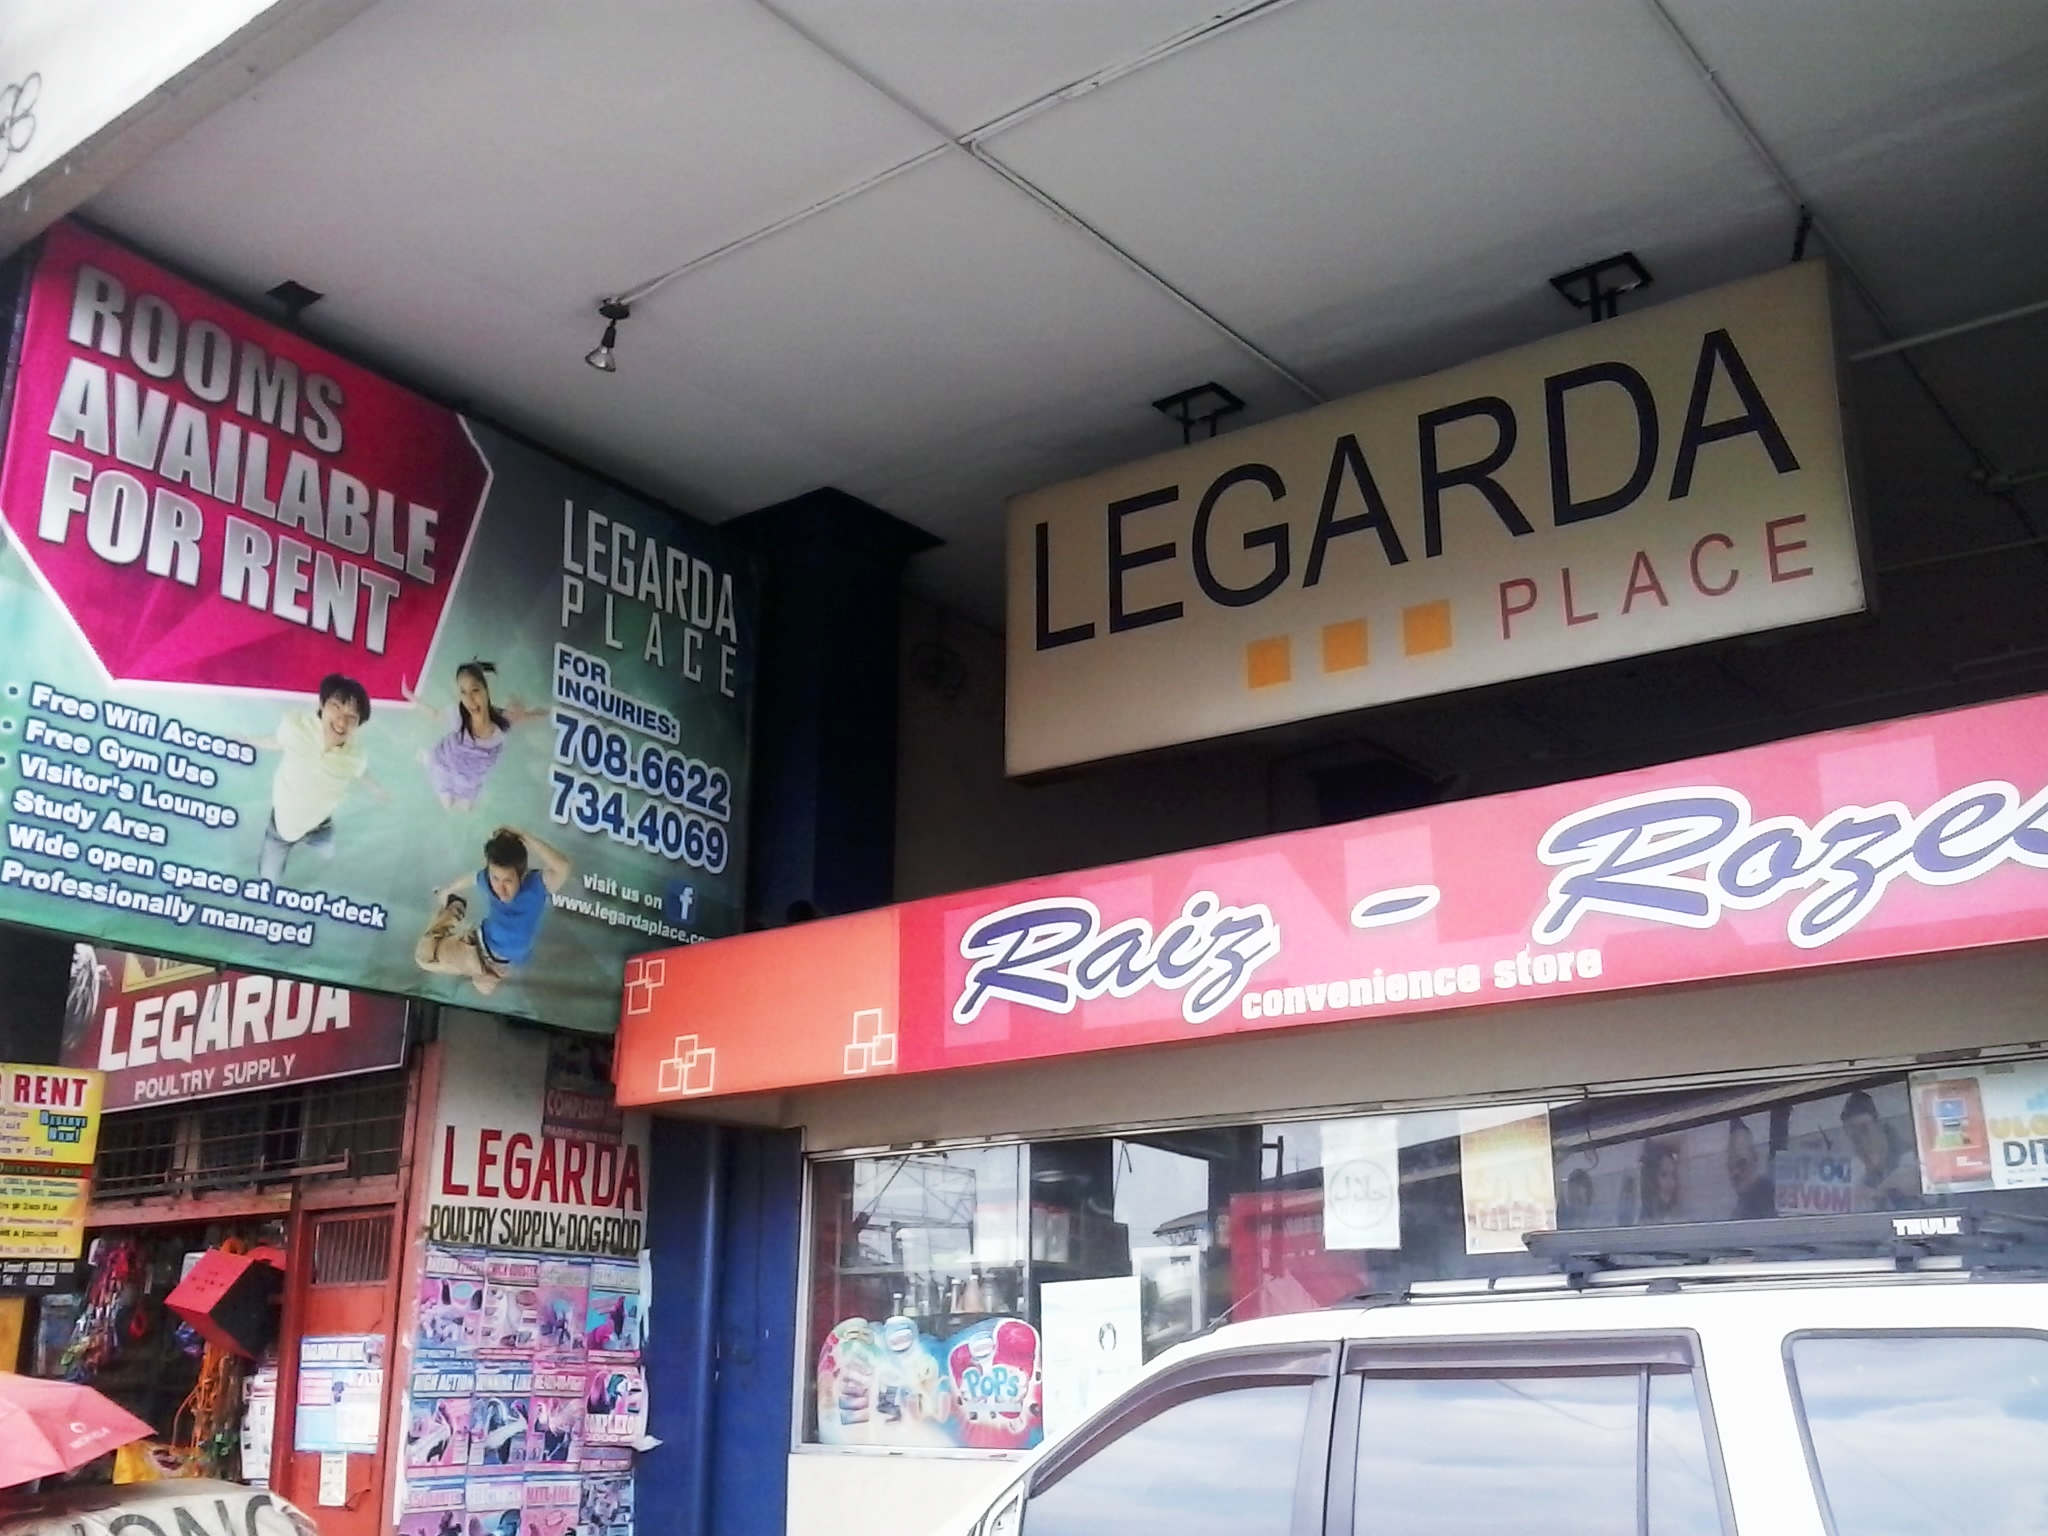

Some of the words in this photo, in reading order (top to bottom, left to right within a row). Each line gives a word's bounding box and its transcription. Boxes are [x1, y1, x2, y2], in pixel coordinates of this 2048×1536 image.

[68, 264, 344, 453] ROOMS
[48, 357, 439, 585] AVAILABLE
[1035, 328, 1800, 651] LEGARDA
[38, 450, 203, 587] FOR
[220, 514, 401, 654] RENT
[563, 498, 740, 644] LEGARDA
[1499, 513, 1814, 640] PLACE
[558, 647, 607, 684] FOR
[561, 574, 737, 699] PLACE
[25, 718, 91, 755] Free
[99, 737, 160, 774] Gym
[166, 755, 217, 787] Use
[31, 682, 98, 720] Free
[103, 702, 157, 737] Wifi
[162, 721, 256, 764] Access
[557, 680, 679, 739] INQUIRIES:
[20, 753, 135, 802] Visitor's
[141, 784, 238, 828] Lounge
[553, 713, 730, 816] 708.6622
[12, 789, 96, 830] Study
[102, 810, 168, 846] Area
[550, 770, 728, 870] 734.4069
[1, 860, 196, 924] Professionally
[200, 905, 314, 946] managed
[8, 823, 80, 860] Wide
[87, 846, 156, 878] open
[161, 865, 239, 896] space
[243, 878, 270, 901] at
[275, 887, 387, 929] roof-deck
[552, 893, 712, 945] www.legardaplace.co
[583, 873, 617, 896] visit
[621, 886, 639, 903] us
[644, 893, 662, 910] on
[952, 890, 1280, 1024] Raiz
[1241, 963, 1481, 1020] convenience
[1494, 944, 1603, 990] store
[98, 975, 351, 1072] LEGARDA
[14, 1074, 88, 1107] RENT
[135, 1068, 216, 1101] POULTRY
[223, 1053, 297, 1086] SUPPLY
[441, 1125, 642, 1211] LEGARDA
[428, 1204, 497, 1244] POULTRY
